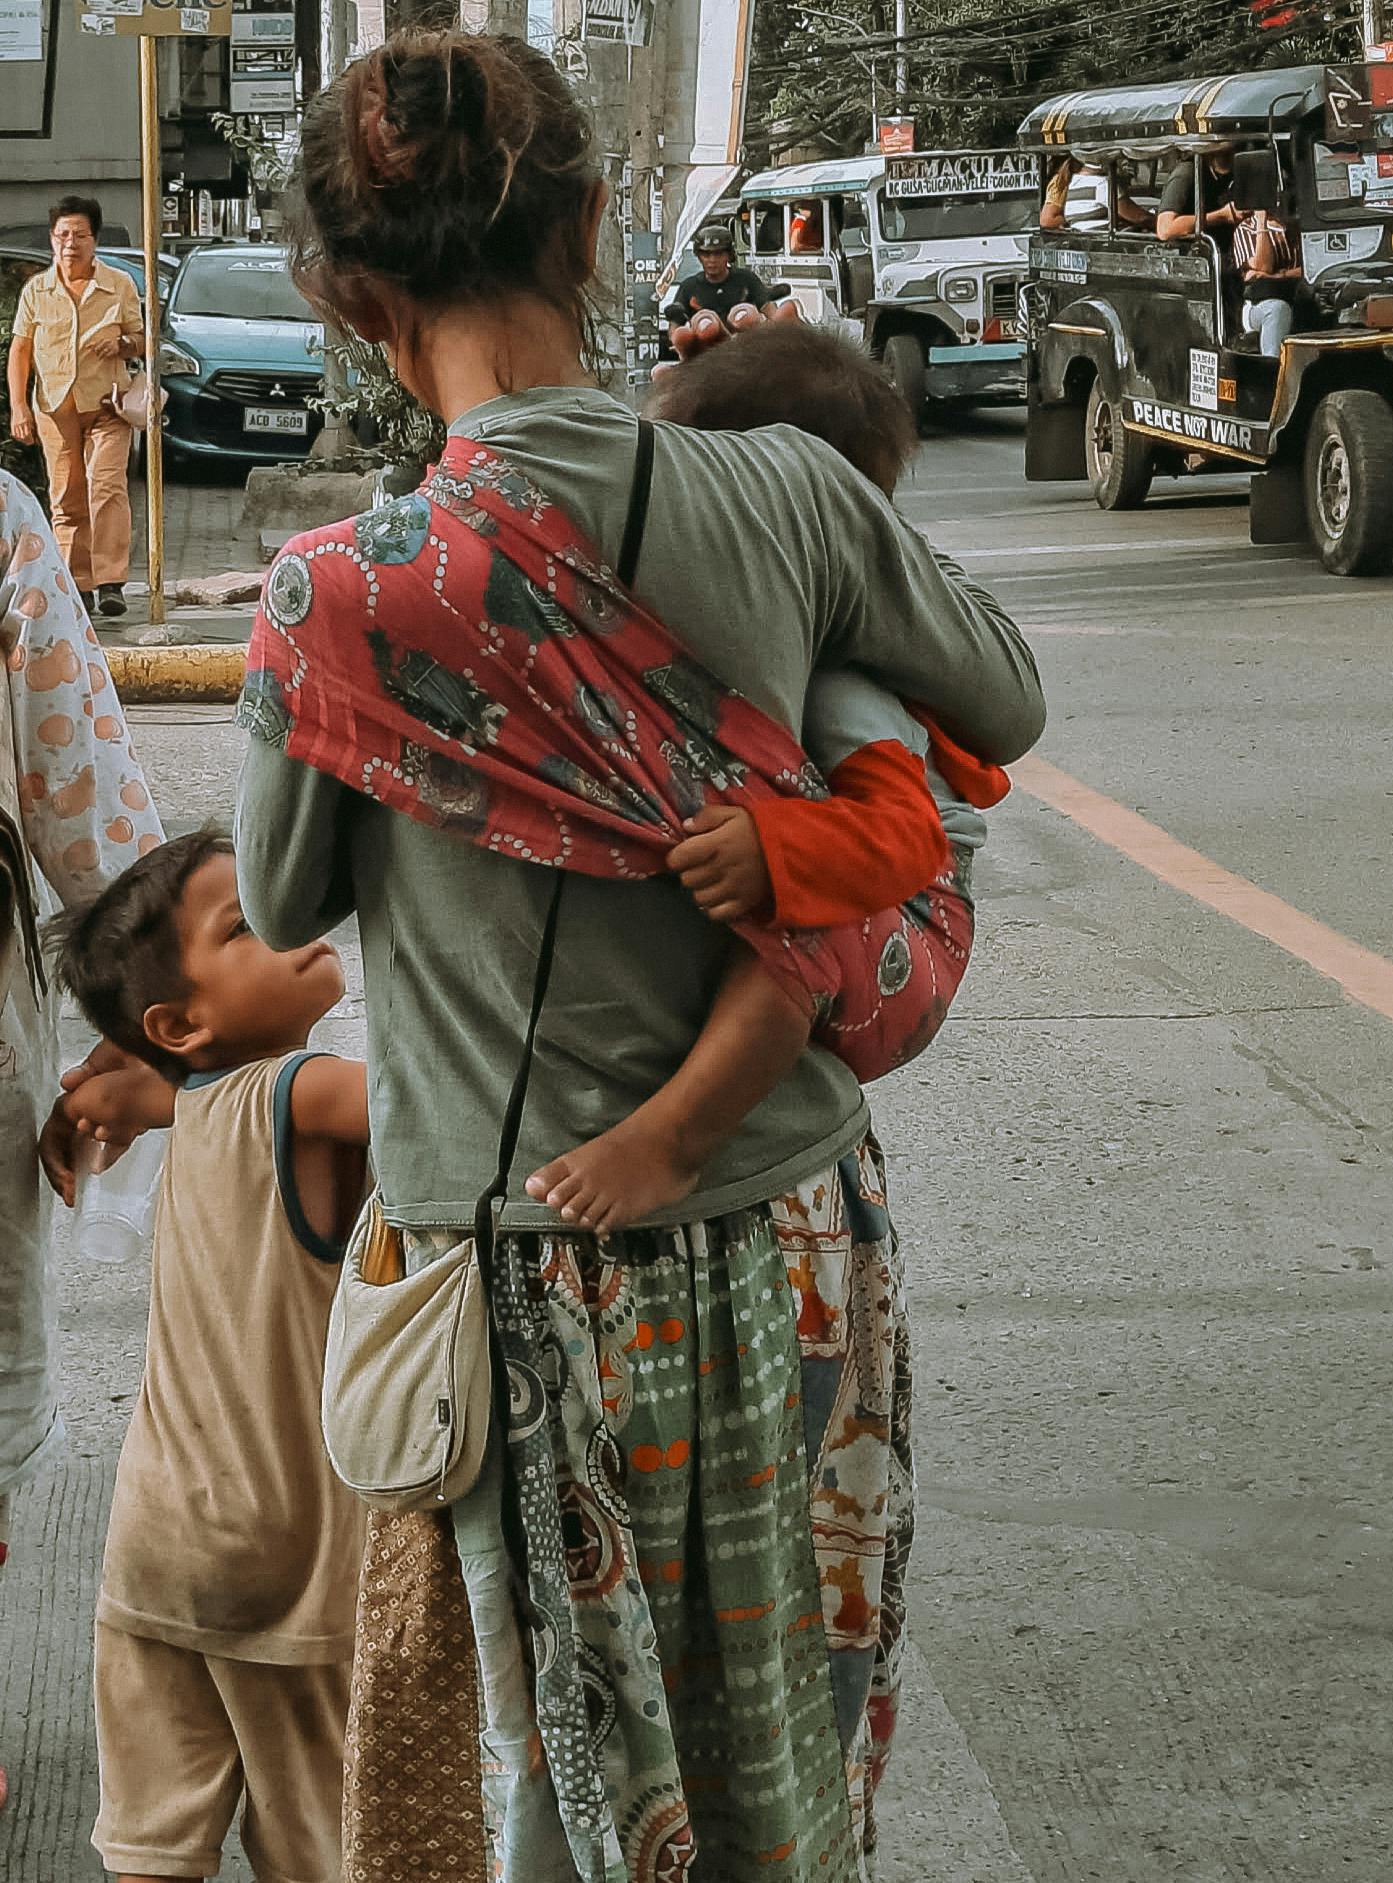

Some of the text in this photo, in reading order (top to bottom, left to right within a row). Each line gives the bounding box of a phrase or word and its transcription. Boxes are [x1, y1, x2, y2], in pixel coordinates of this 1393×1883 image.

[1133, 401, 1252, 450] PEACE NOT WAR
